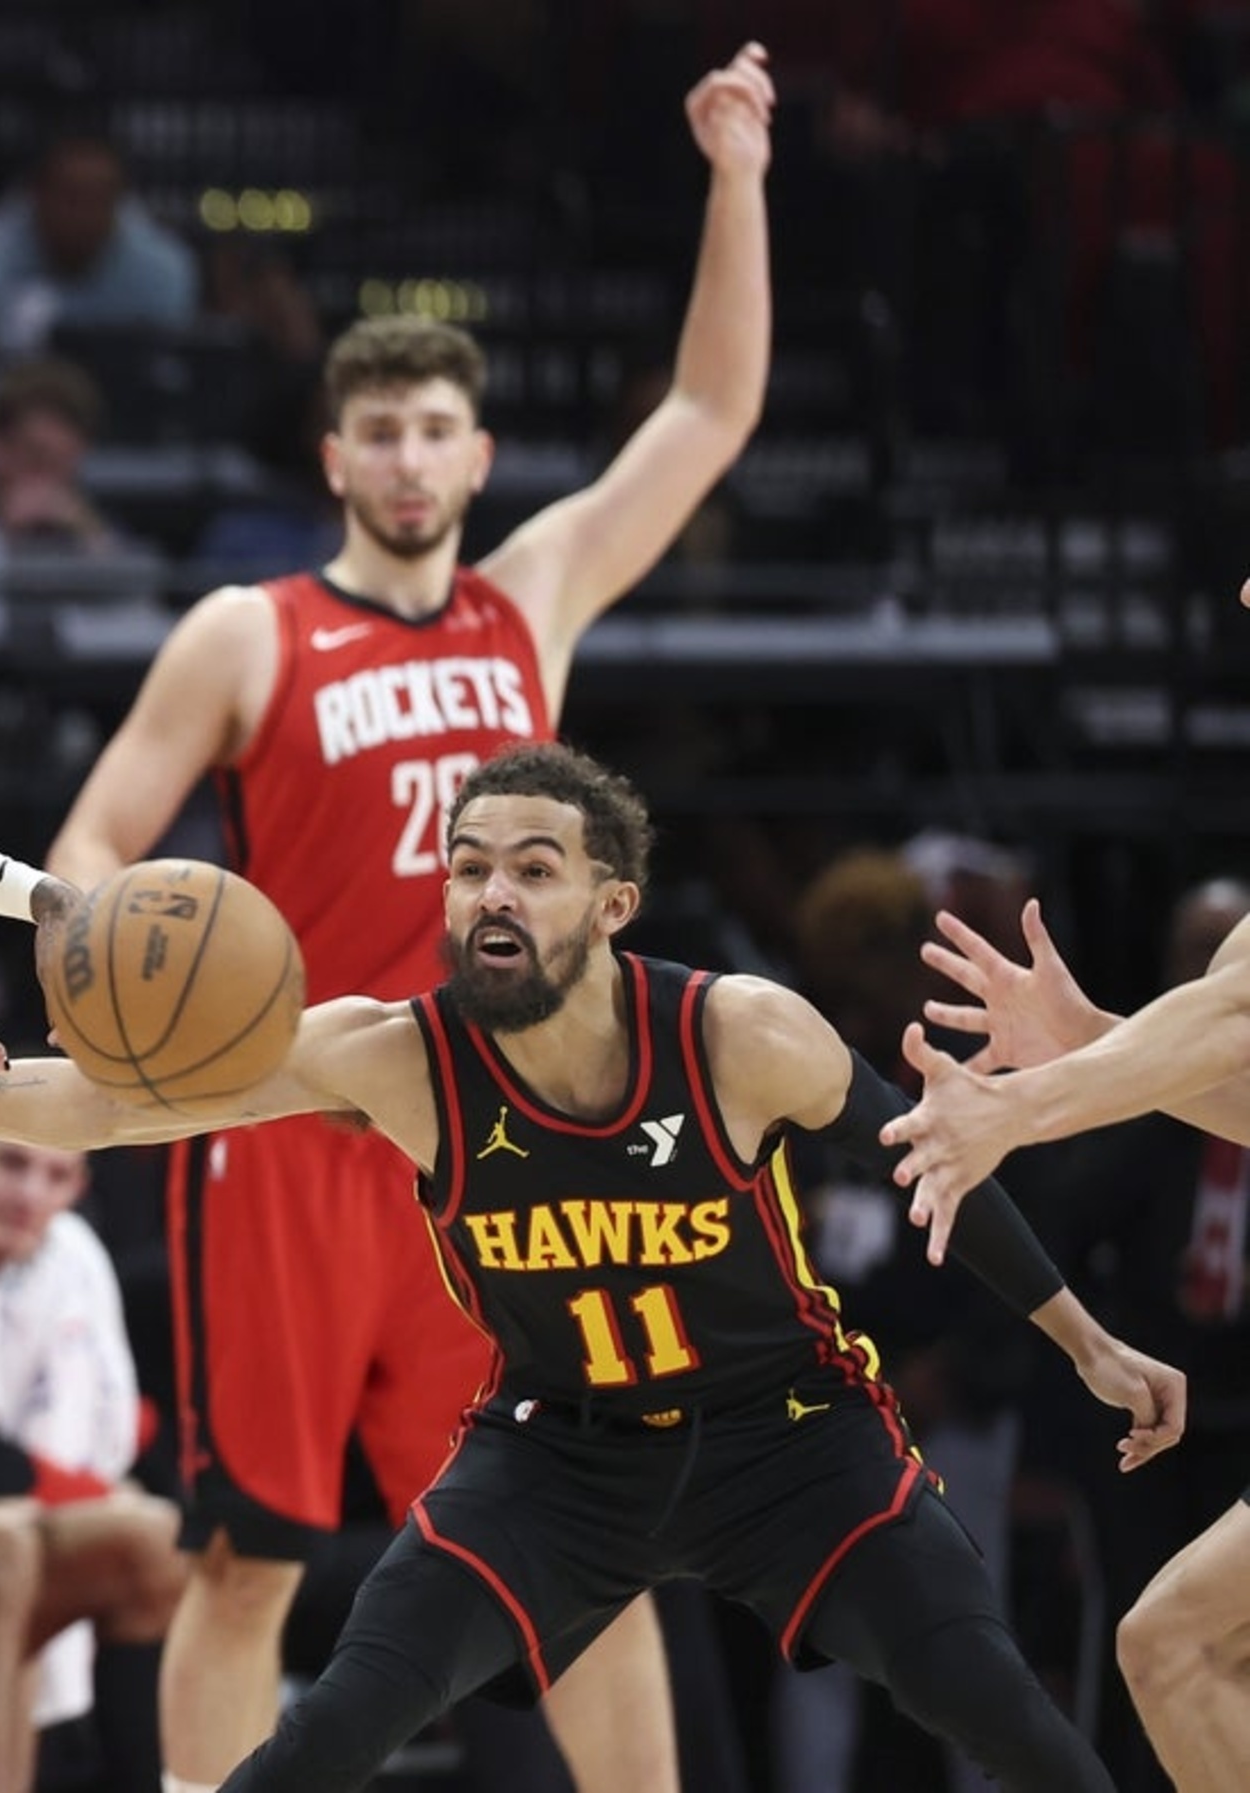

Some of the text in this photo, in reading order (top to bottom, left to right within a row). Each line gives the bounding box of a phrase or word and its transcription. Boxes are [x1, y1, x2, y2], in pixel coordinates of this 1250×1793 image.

[314, 655, 534, 766] ROCKETS
[465, 1198, 732, 1271] HAWKS
[569, 1284, 700, 1387] 11
